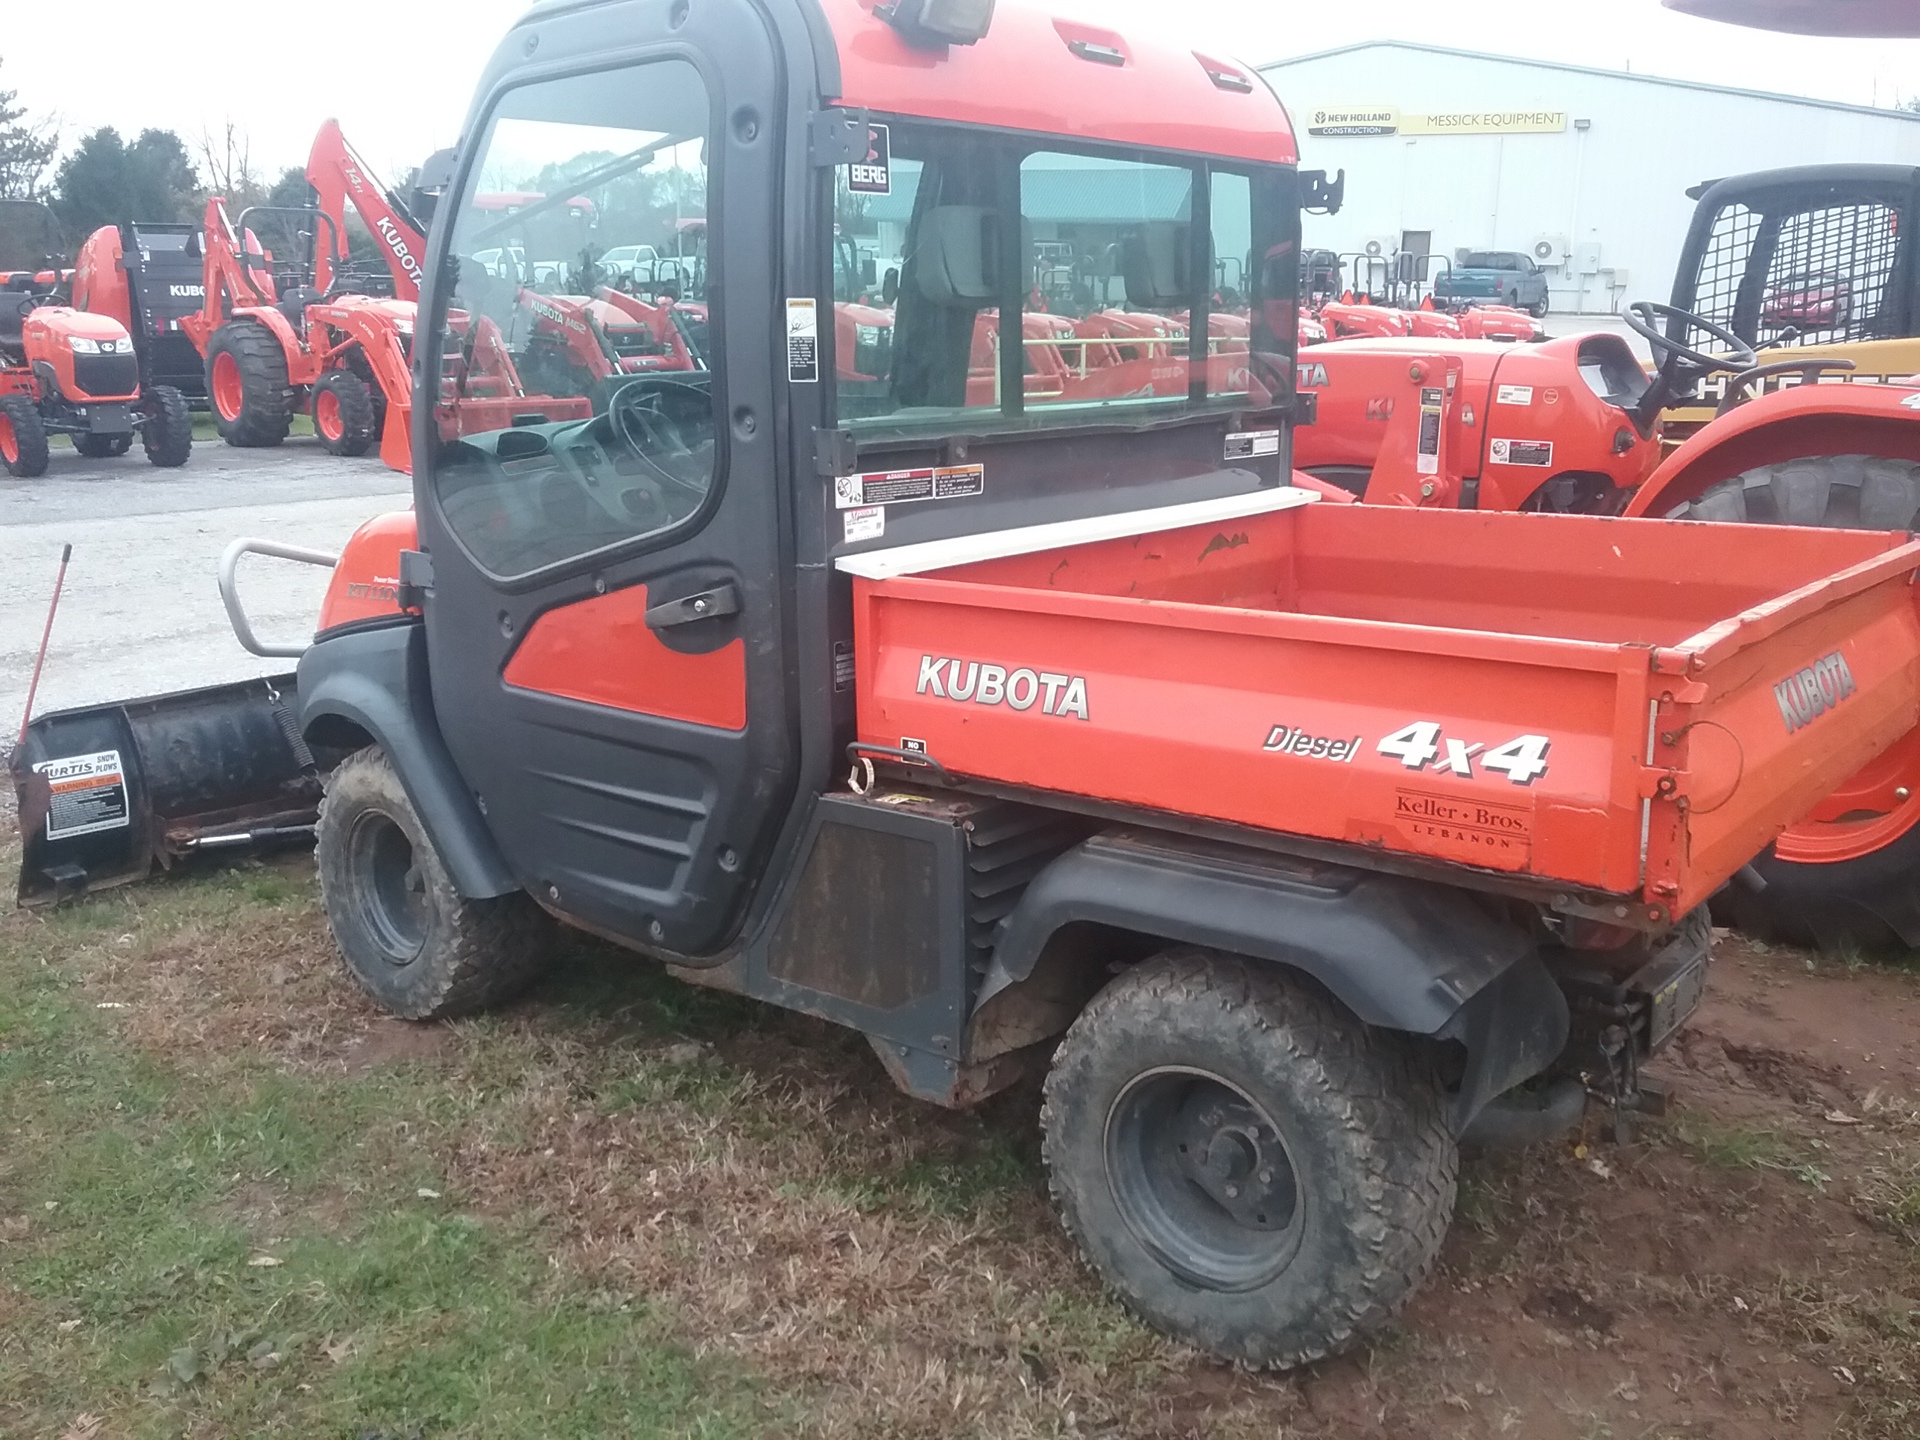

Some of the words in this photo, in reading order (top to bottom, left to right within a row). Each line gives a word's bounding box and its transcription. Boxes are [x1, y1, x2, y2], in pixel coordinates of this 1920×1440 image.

[1328, 114, 1348, 123] NEW
[1350, 113, 1391, 122] HOLLAND
[1427, 114, 1479, 127] MESSICK
[1483, 112, 1564, 126] EQUIPMENT
[1322, 126, 1381, 135] CONSTRUCTION
[851, 164, 887, 184] BERG
[531, 299, 564, 325] KUBOTA
[348, 583, 399, 601] RTV110
[916, 655, 1090, 722] KUBOTA
[1773, 650, 1857, 734] KUBOTA
[908, 741, 919, 749] NO
[1263, 723, 1363, 763] Diesel
[1376, 720, 1551, 787] 4x4
[97, 753, 116, 763] SNOW
[96, 763, 117, 773] PLOWS
[54, 780, 93, 792] WARNING
[1397, 796, 1458, 819] Keller
[1475, 808, 1529, 831] Bros.
[1414, 824, 1511, 848] LEBANON
